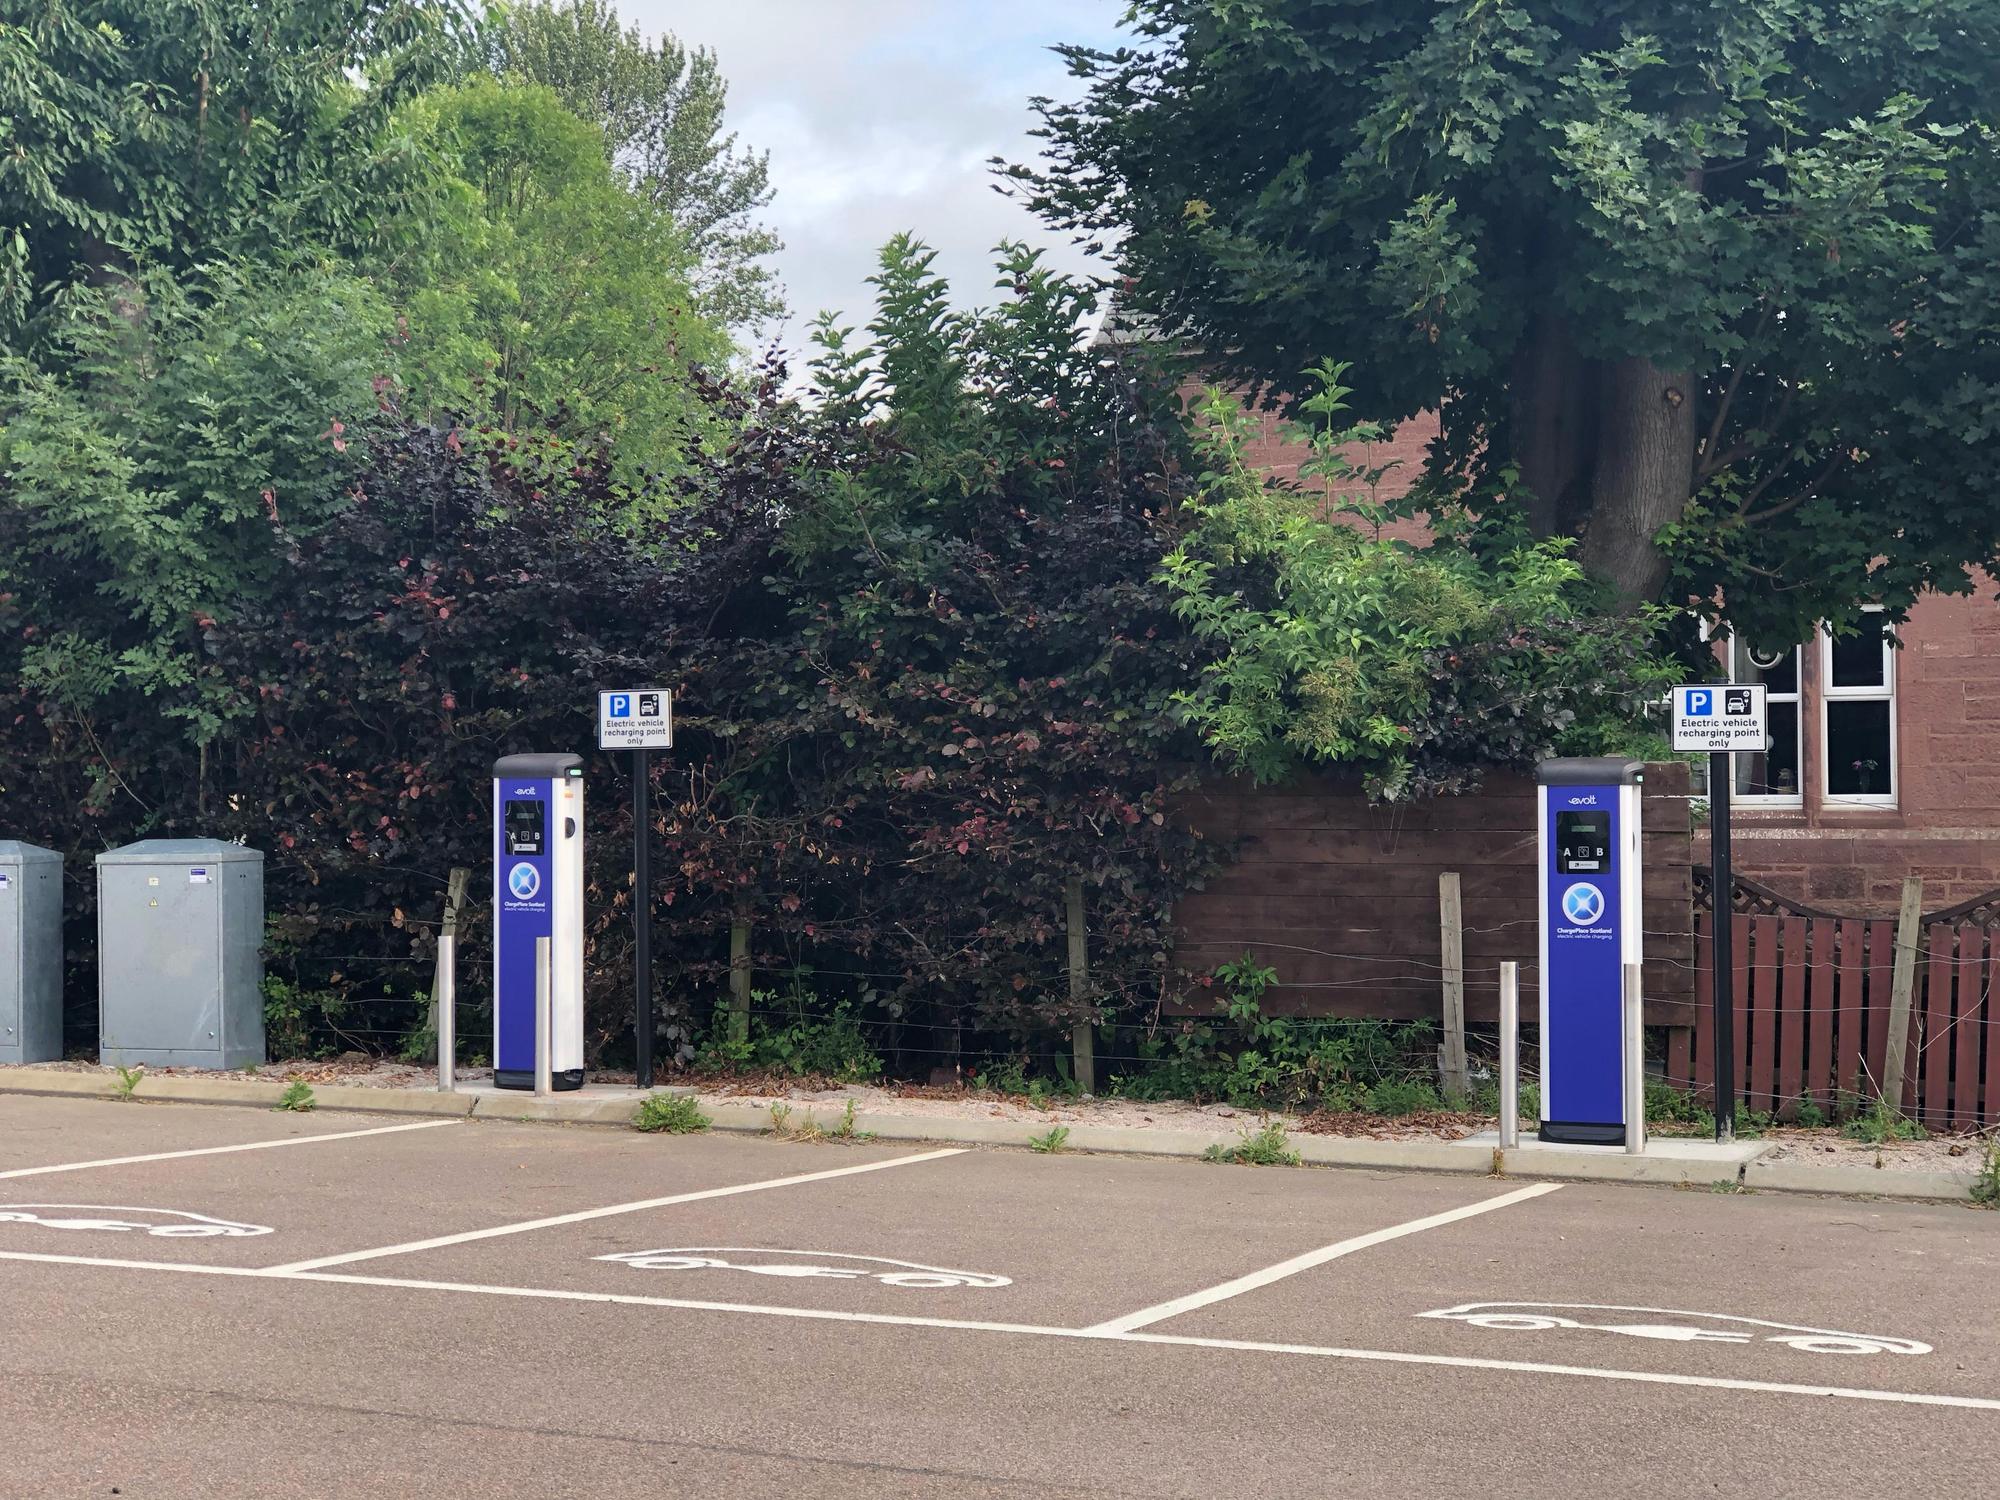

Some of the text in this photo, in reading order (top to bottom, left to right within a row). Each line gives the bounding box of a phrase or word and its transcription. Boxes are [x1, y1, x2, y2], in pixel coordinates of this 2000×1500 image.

[614, 697, 626, 715] P
[1691, 692, 1707, 713] P
[606, 719, 664, 728] Electric vehicle
[1681, 718, 1757, 728] Electric vehicle
[604, 728, 666, 737] recharging point
[1678, 728, 1760, 738] recharging point
[1708, 739, 1730, 748] only
[1568, 795, 1597, 804] evolt
[510, 832, 516, 840] A
[535, 832, 541, 840] B
[1563, 848, 1571, 856] A
[1596, 848, 1603, 856] B
